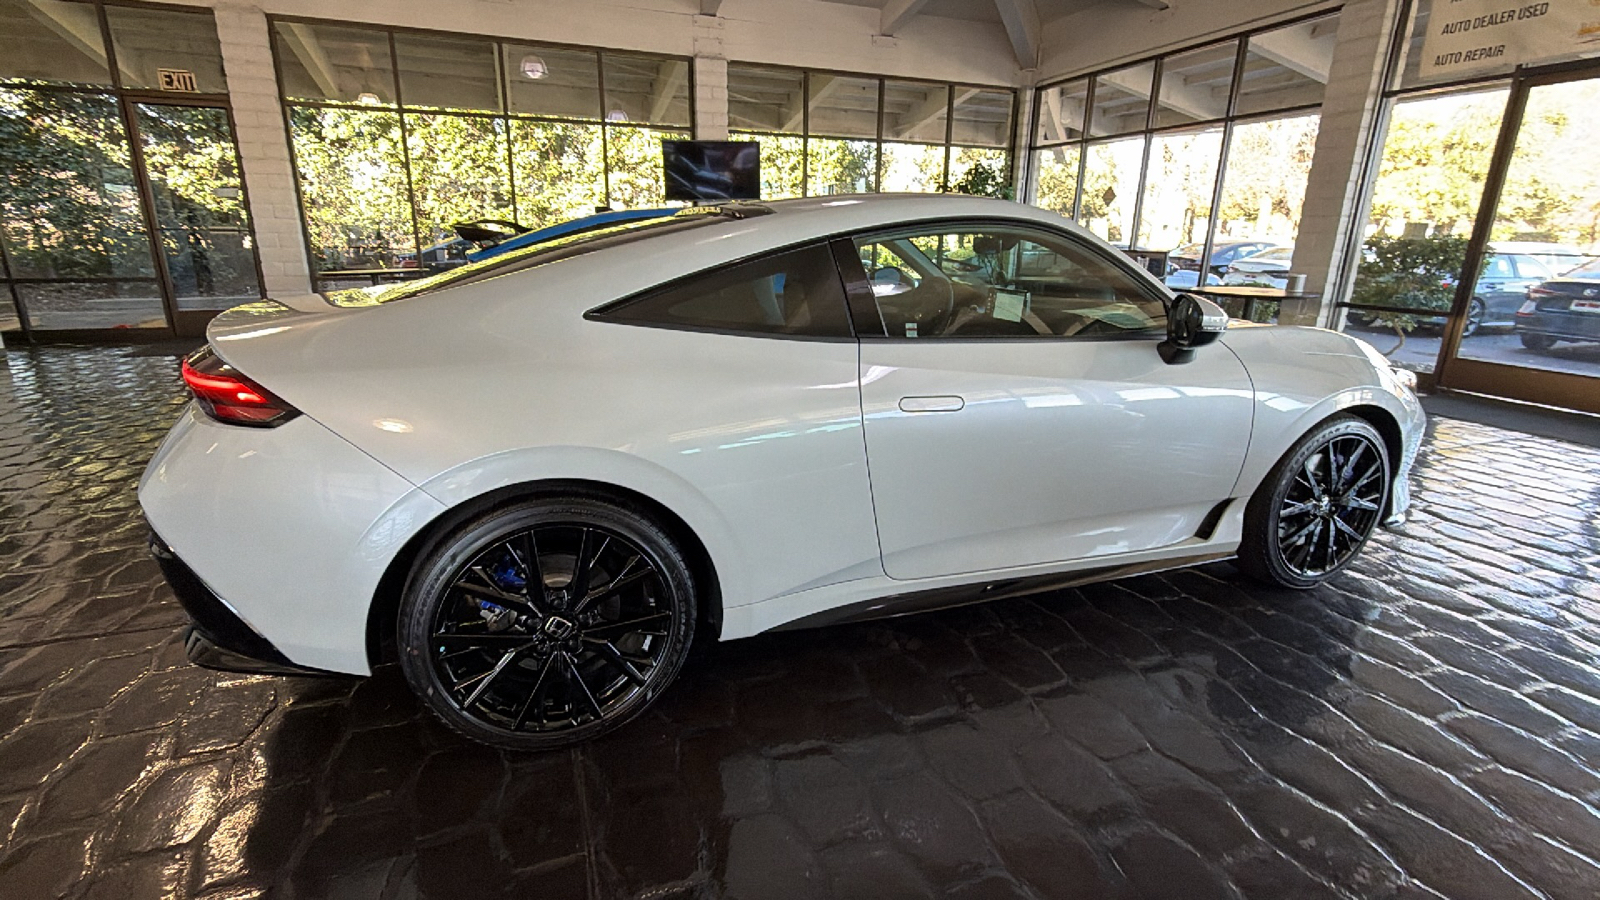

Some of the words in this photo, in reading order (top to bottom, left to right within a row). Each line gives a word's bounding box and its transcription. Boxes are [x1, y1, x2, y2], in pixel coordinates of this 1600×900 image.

[1441, 19, 1471, 36] AUTO
[1473, 9, 1516, 29] DEALER
[1517, 2, 1549, 20] USED
[1433, 52, 1462, 67] AUTO
[1463, 44, 1506, 63] REPAIR
[161, 72, 193, 91] EXIT
